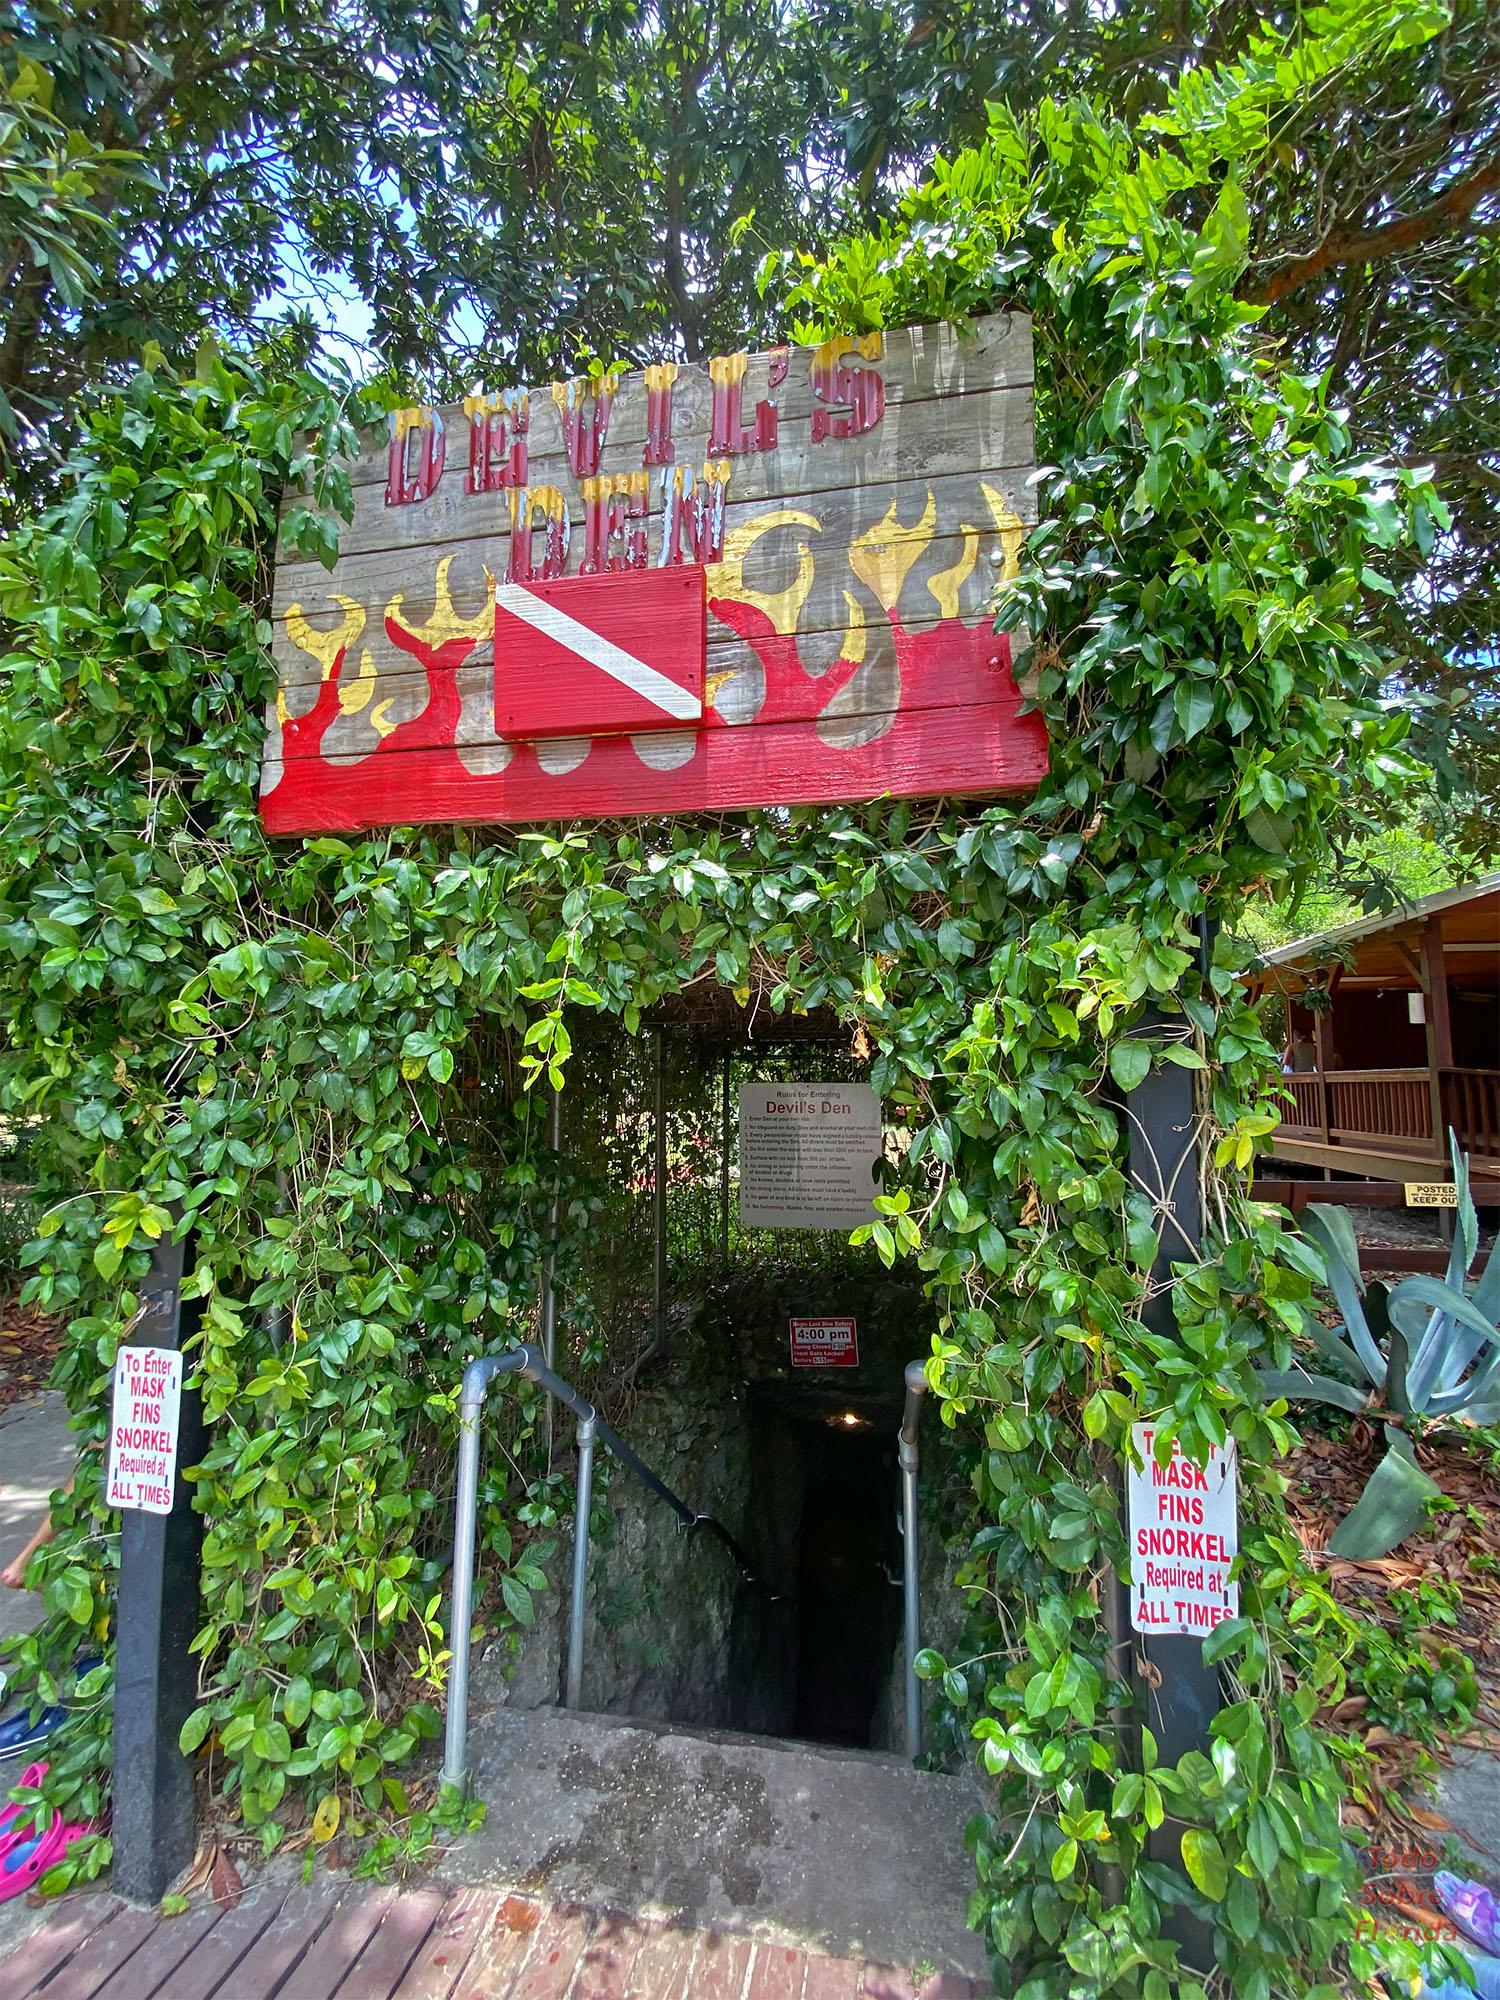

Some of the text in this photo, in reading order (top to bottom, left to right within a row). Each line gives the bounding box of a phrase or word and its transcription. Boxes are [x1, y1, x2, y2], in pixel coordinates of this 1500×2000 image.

[384, 332, 886, 507] DEVIL'S
[506, 460, 731, 582] DEN
[766, 1101, 851, 1114] Devil's Den
[810, 1091, 841, 1100] Entering
[798, 1329, 849, 1341] 4:00 pm
[126, 1354, 172, 1375] To Enter
[130, 1376, 166, 1399] MASK
[132, 1402, 160, 1425] FINS
[116, 1427, 172, 1454] SNORKEL
[119, 1452, 166, 1478] Required at
[1152, 1461, 1208, 1492] MASK
[111, 1482, 171, 1506] ALL TIMES
[1158, 1494, 1204, 1525] FINS
[1137, 1528, 1231, 1563] SNORKEL
[1146, 1562, 1223, 1594] Required at
[1137, 1601, 1170, 1624] ALL
